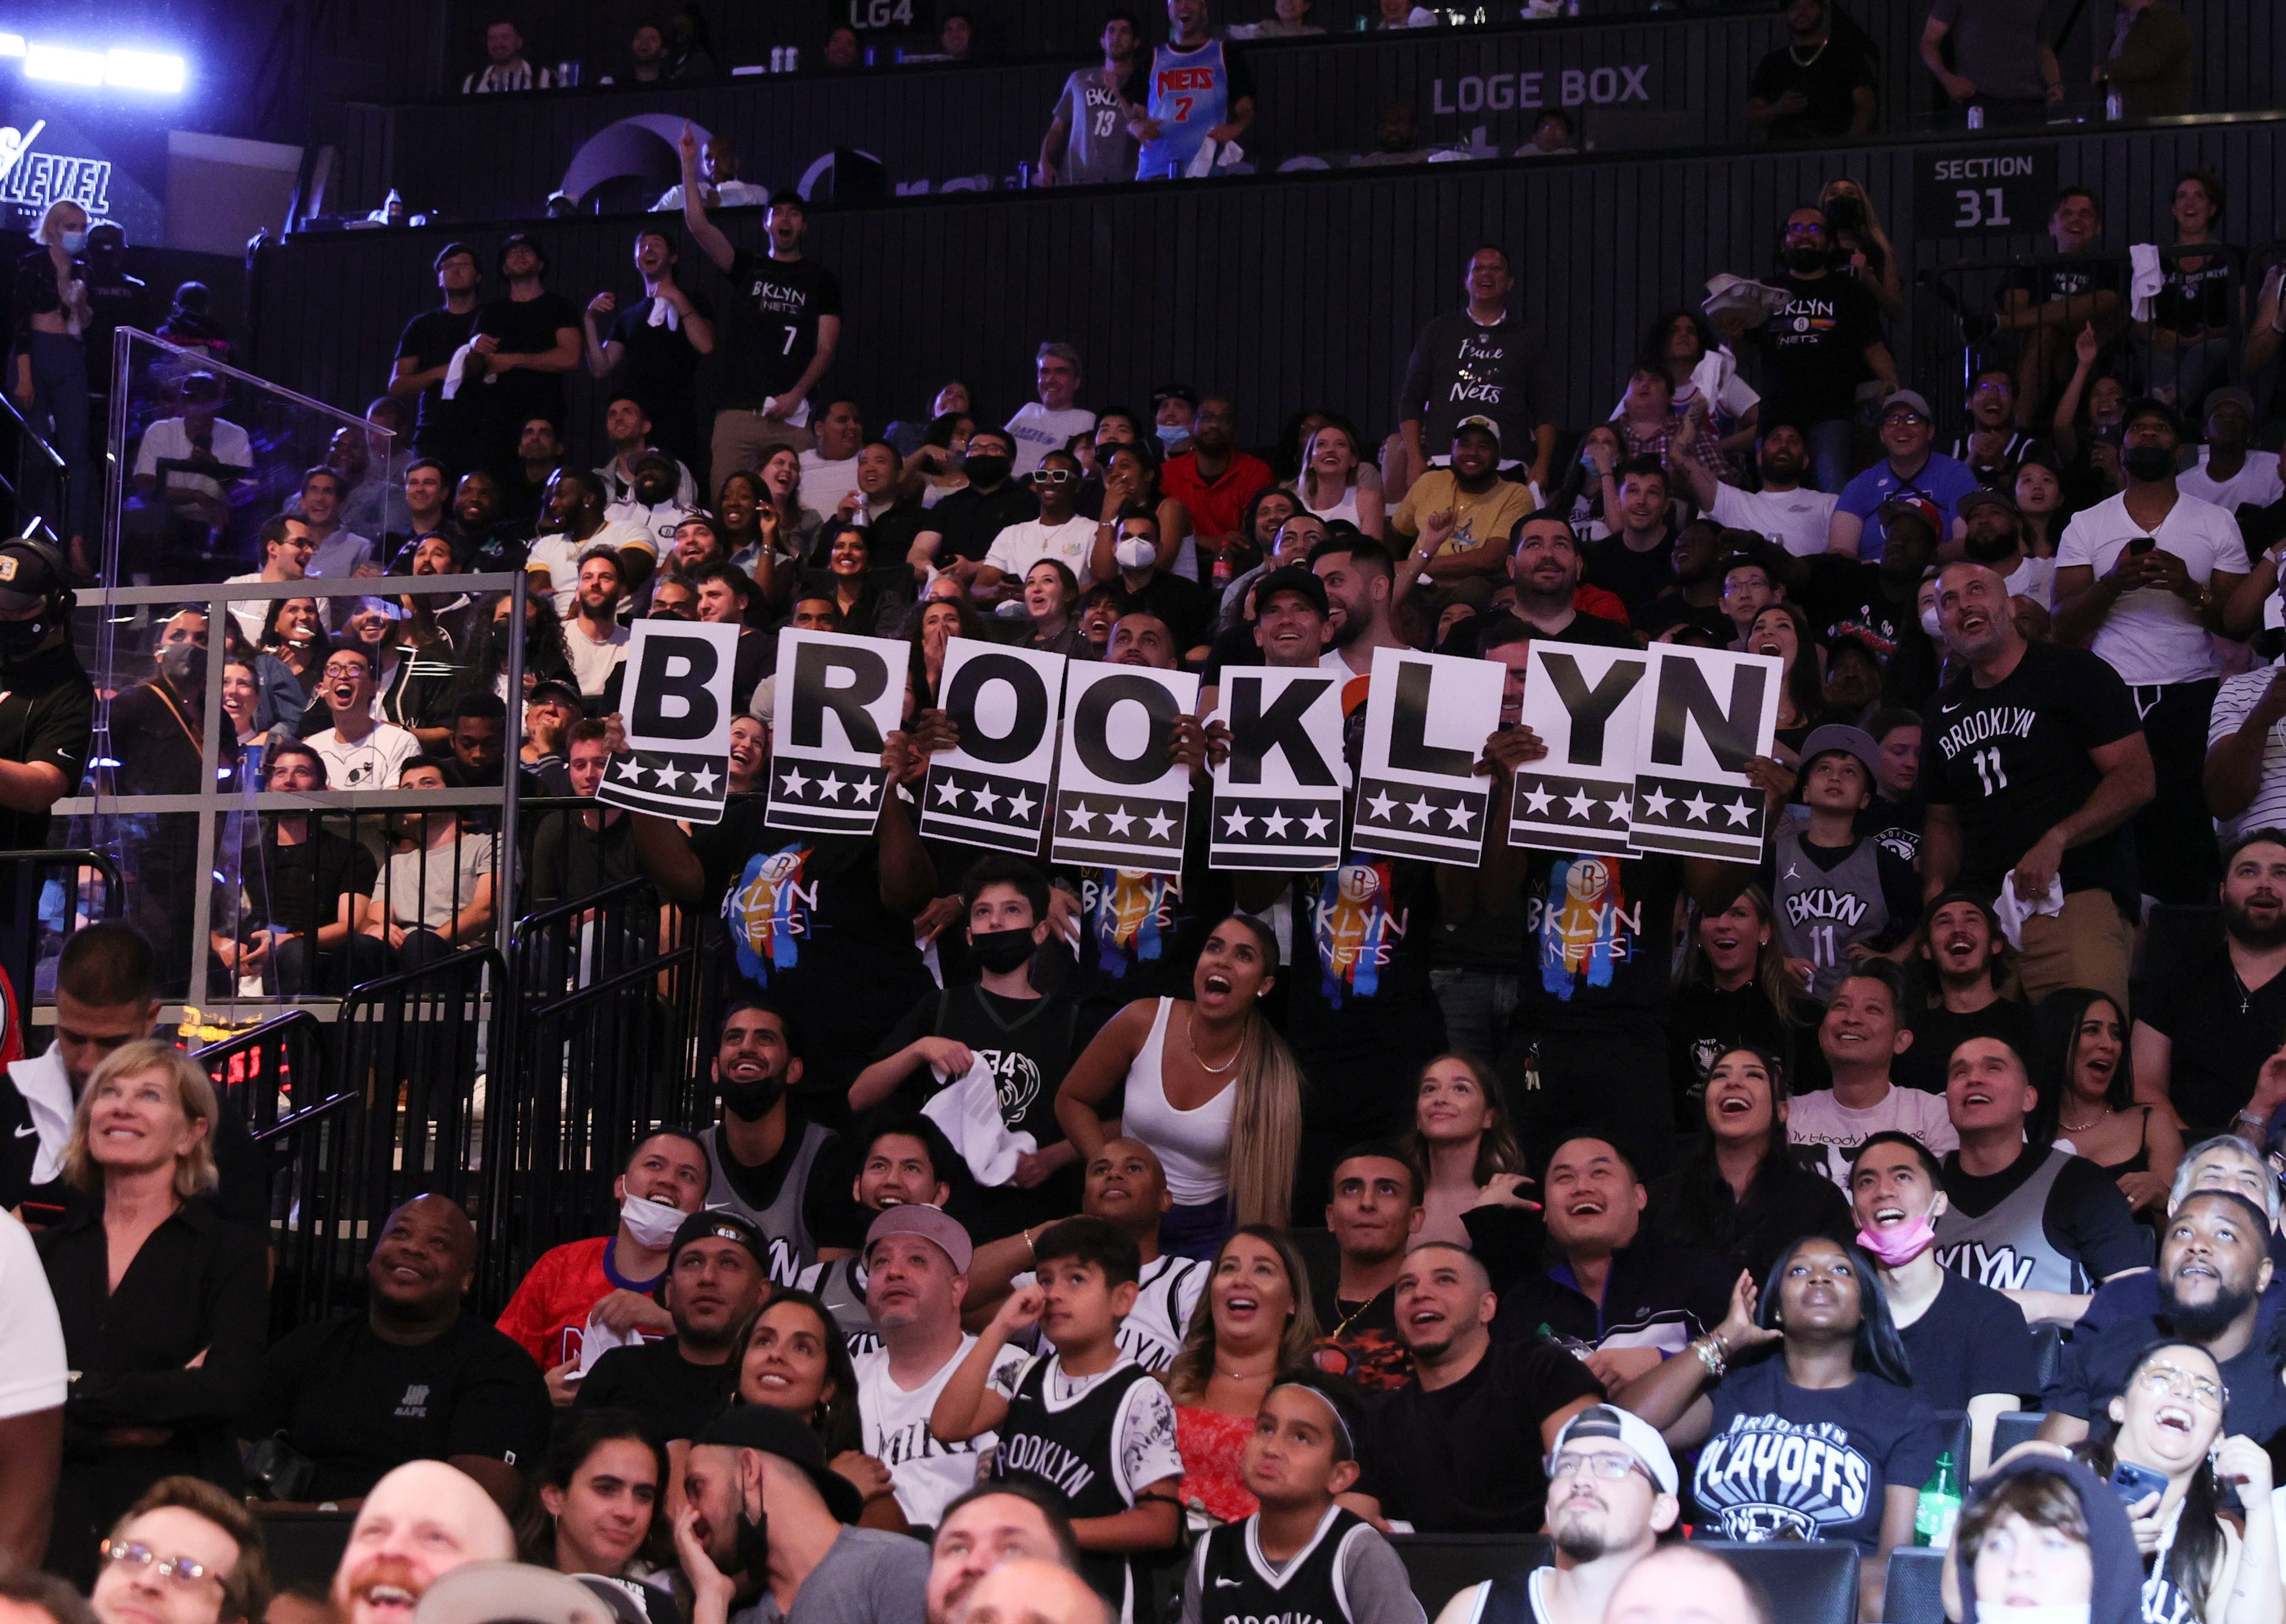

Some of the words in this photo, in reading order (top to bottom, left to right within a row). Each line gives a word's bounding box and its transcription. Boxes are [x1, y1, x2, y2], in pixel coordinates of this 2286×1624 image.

[851, 0, 914, 29] LG4
[1157, 68, 1214, 99] NETS
[1433, 71, 1544, 115] LOGE
[1561, 64, 1650, 107] BOX
[1094, 110, 1116, 137] 13
[1175, 97, 1193, 121] 7
[1934, 155, 2033, 181] SECTION
[1954, 187, 2011, 228] 31
[751, 280, 807, 306] BKLYN
[763, 300, 798, 314] NETS
[782, 326, 798, 355] 7
[1449, 380, 1505, 404] Nets
[1938, 706, 2037, 761] BROOKLYN
[1972, 745, 2008, 797] 11
[1082, 874, 1184, 917] BKLYN
[1785, 887, 1869, 928] BKLYN
[736, 913, 805, 945] NETS
[1101, 906, 1173, 939] NETS
[1526, 897, 1642, 938] BKLYN
[1319, 940, 1393, 969] NETS
[1548, 937, 1627, 963] NETS
[1809, 925, 1836, 968] 11
[997, 1432, 1096, 1499] ROOKLYN
[1694, 1433, 1868, 1518] PLAYOFFS
